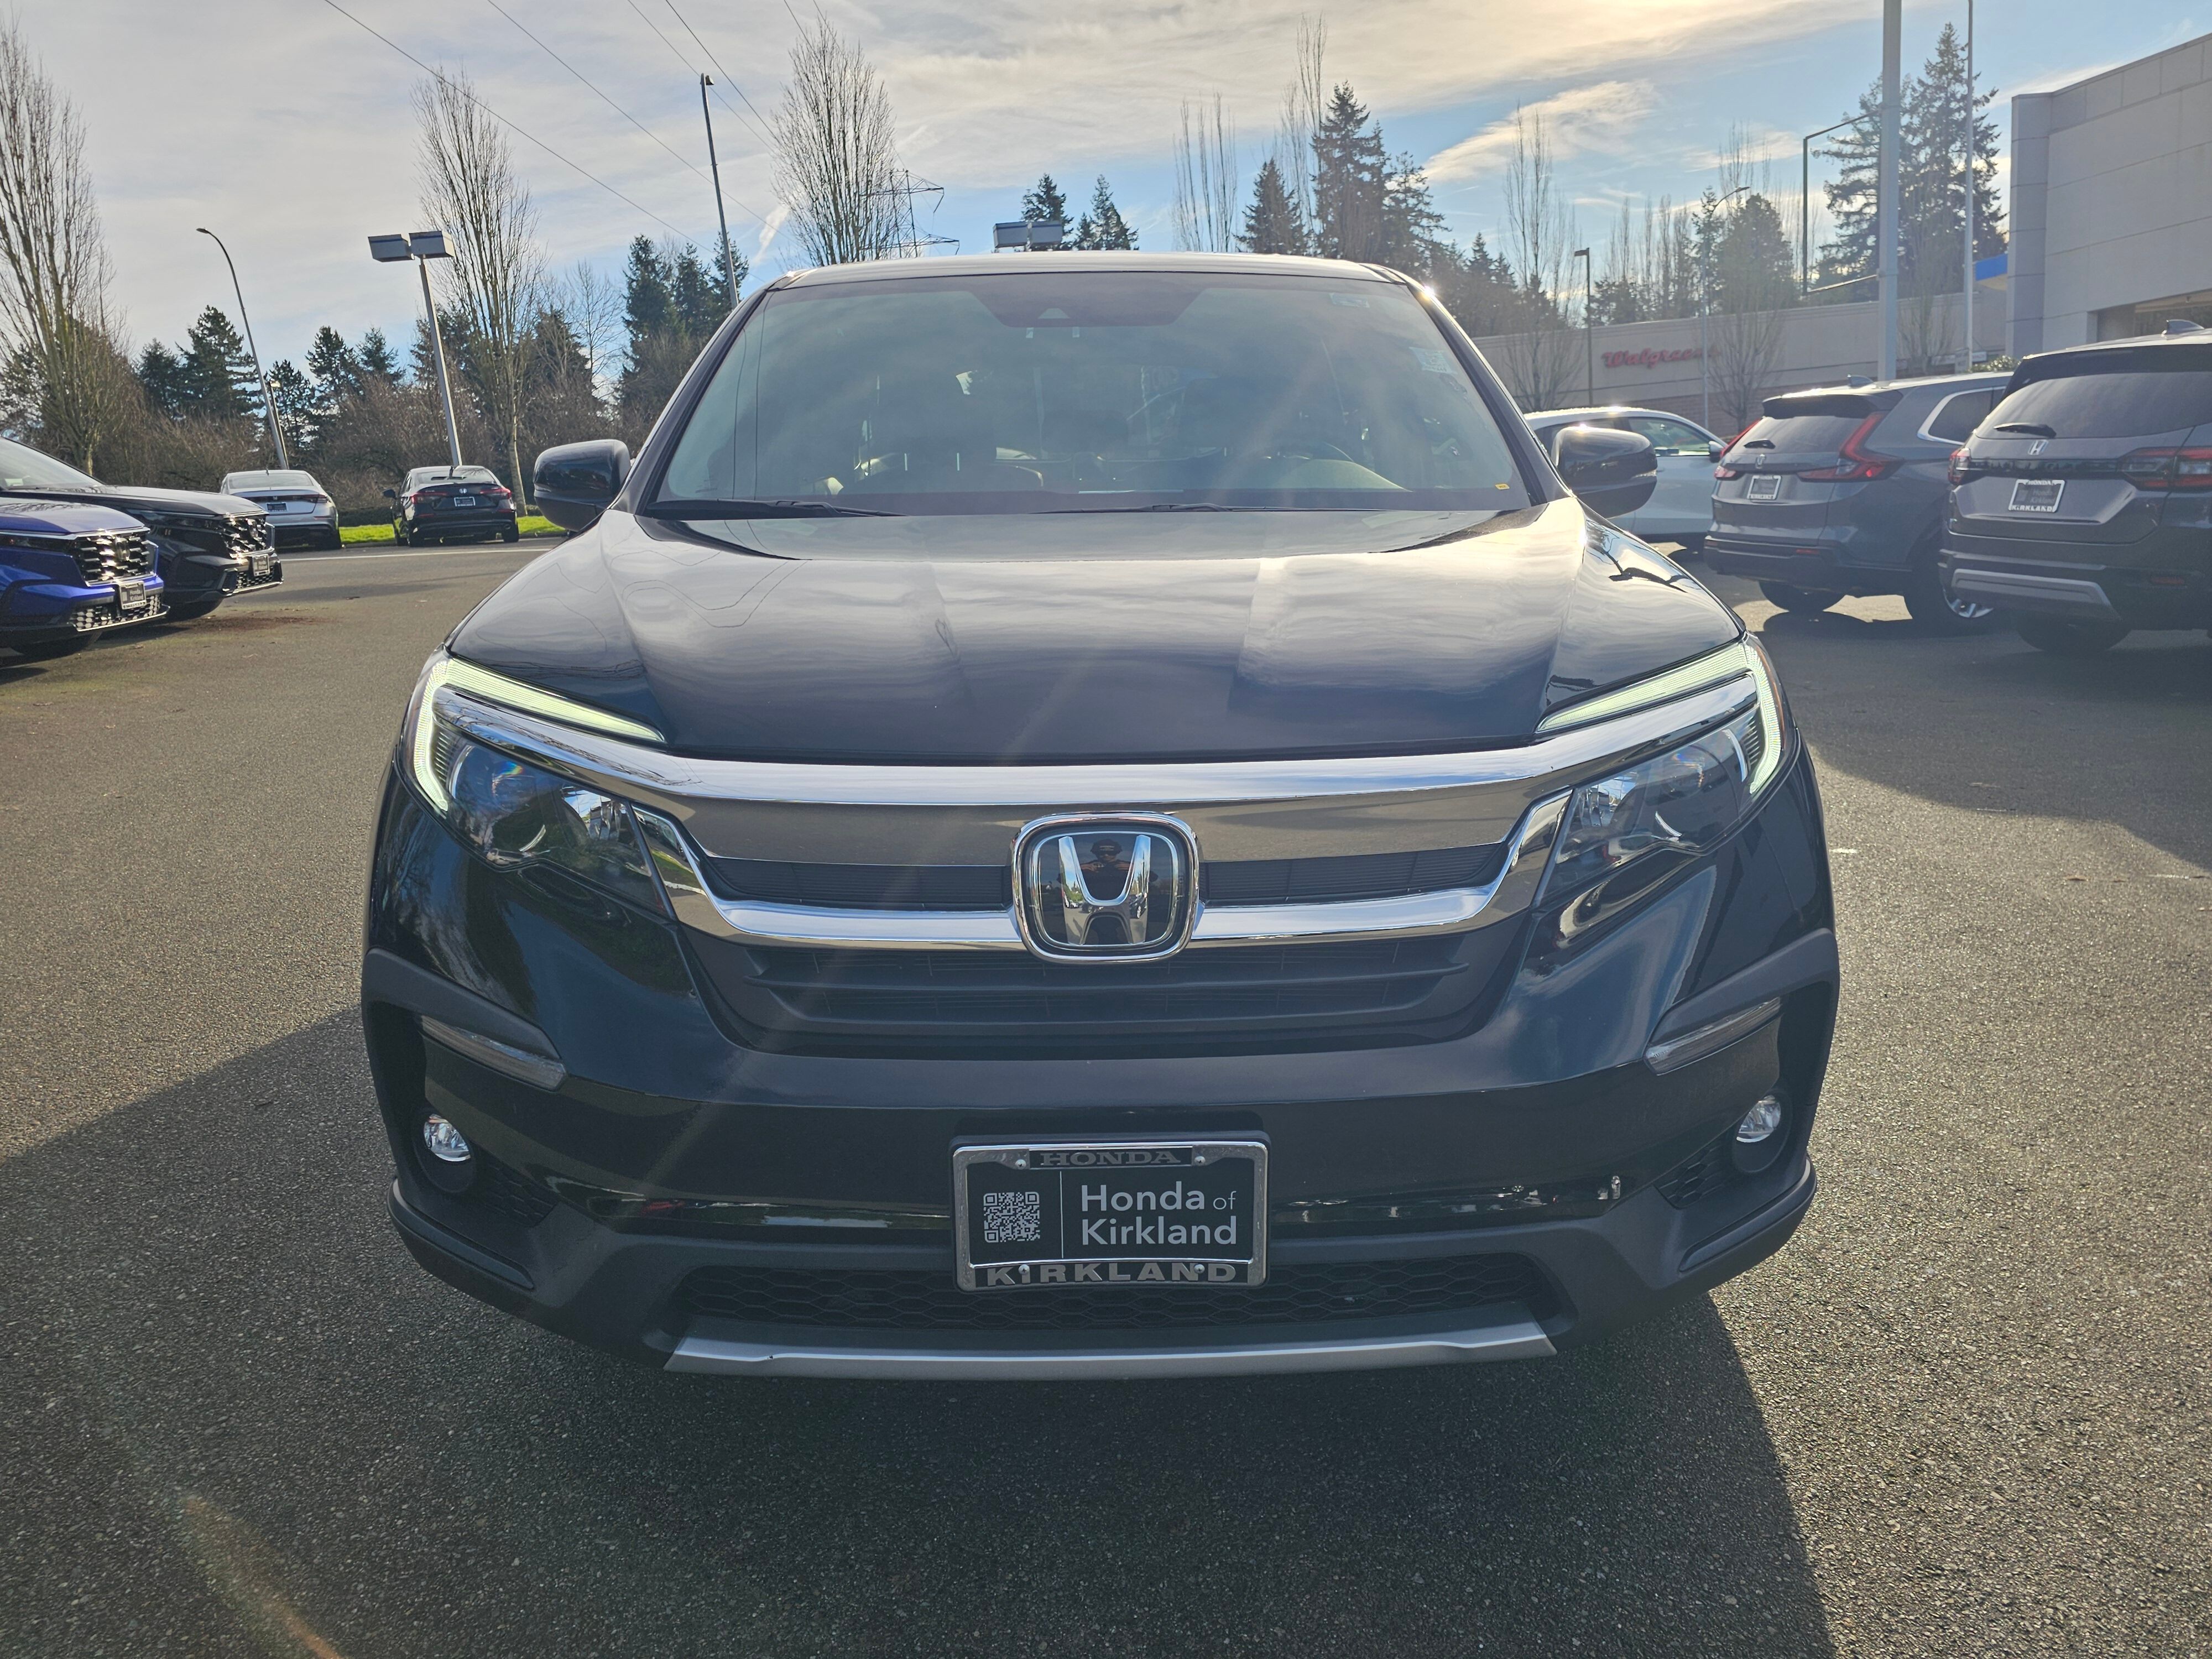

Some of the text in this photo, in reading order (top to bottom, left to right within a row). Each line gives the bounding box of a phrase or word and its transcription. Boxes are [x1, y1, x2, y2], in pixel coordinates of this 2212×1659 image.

[1601, 347, 1721, 369] Walgreen
[1040, 1151, 1181, 1166] HONDA
[1082, 1181, 1237, 1211] Honda of
[1082, 1215, 1237, 1245] Kirkland
[987, 1262, 1237, 1286] KIRKLAND
